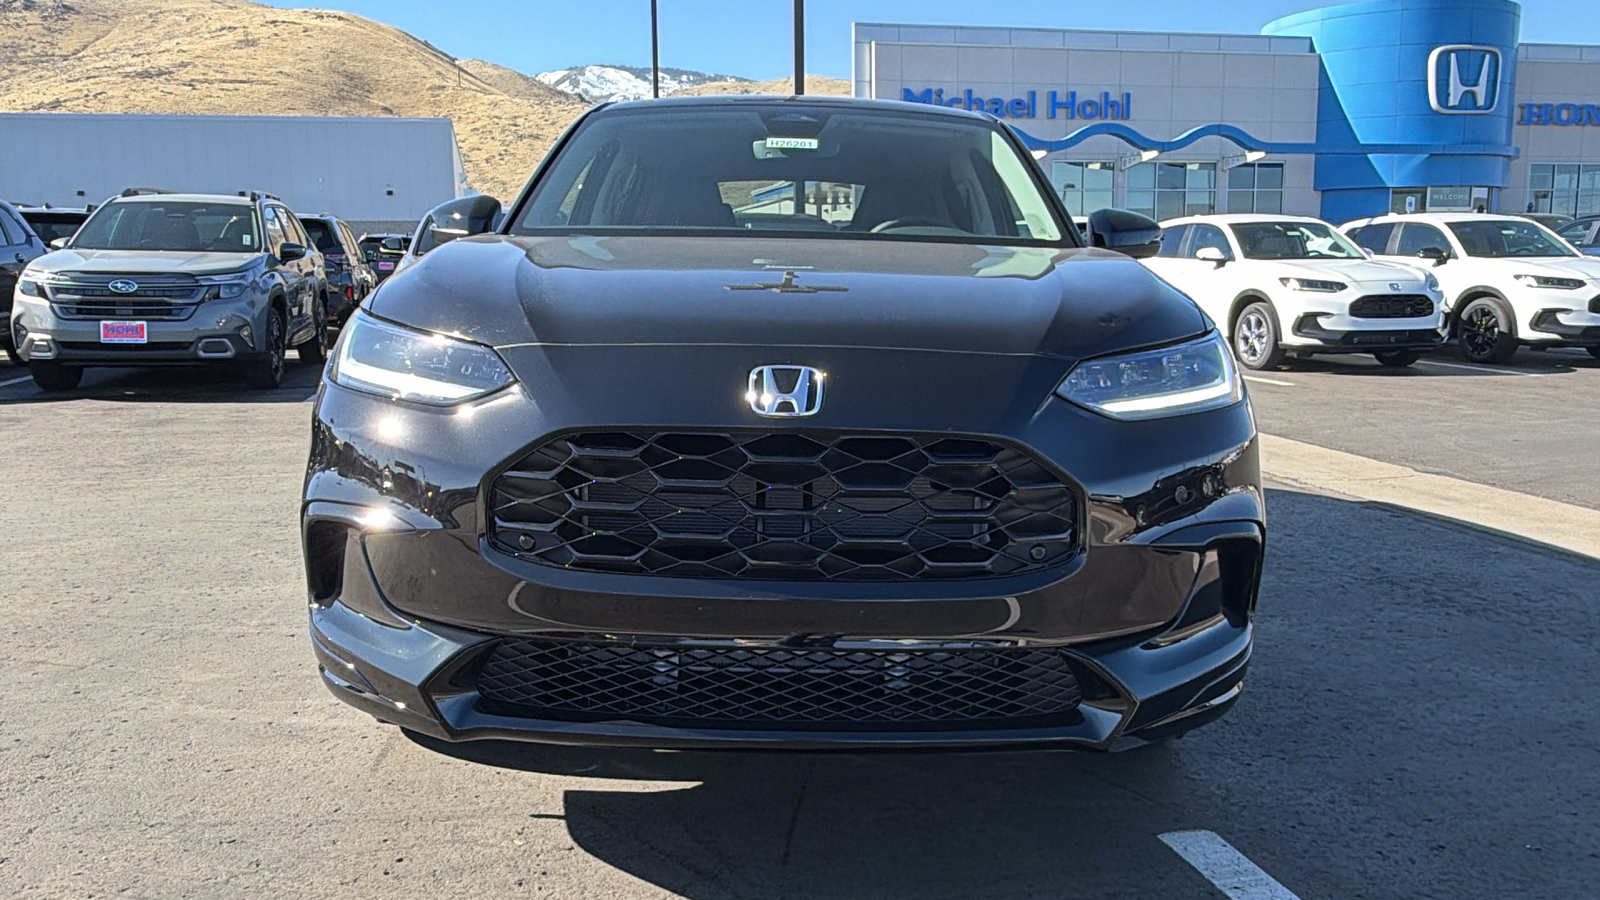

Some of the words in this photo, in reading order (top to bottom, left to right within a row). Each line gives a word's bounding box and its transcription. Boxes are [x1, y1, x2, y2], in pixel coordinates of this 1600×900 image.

[902, 88, 1036, 118] Michael
[1048, 91, 1131, 119] Hohl
[770, 140, 813, 148] H26201
